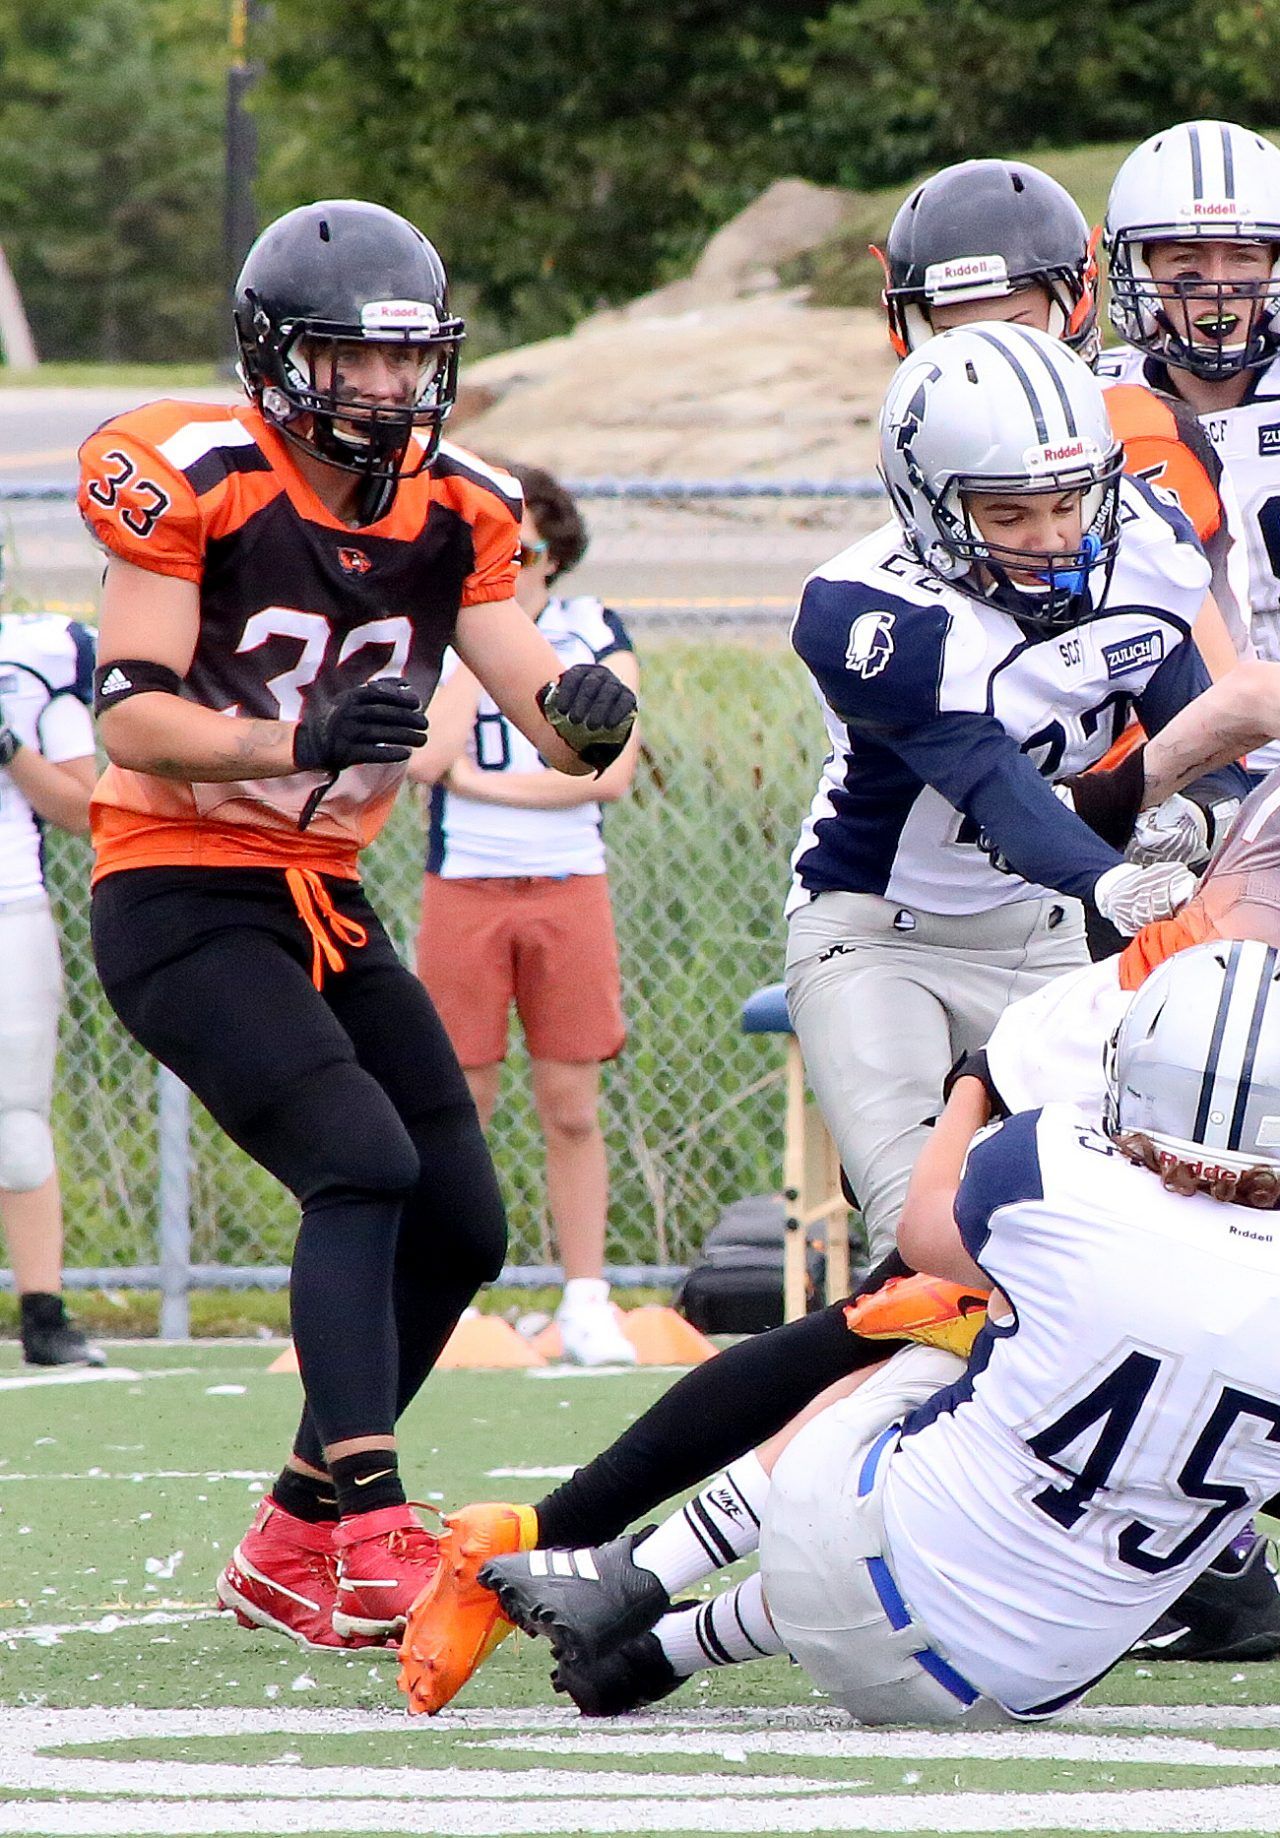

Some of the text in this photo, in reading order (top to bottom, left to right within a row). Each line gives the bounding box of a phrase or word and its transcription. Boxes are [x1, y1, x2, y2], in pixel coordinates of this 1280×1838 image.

[1194, 204, 1236, 215] Riddell
[945, 261, 987, 278] Riddell
[1044, 443, 1083, 461] Riddell
[87, 449, 170, 538] 33
[1107, 641, 1151, 667] ZULICH
[1229, 1225, 1274, 1243] Riddell
